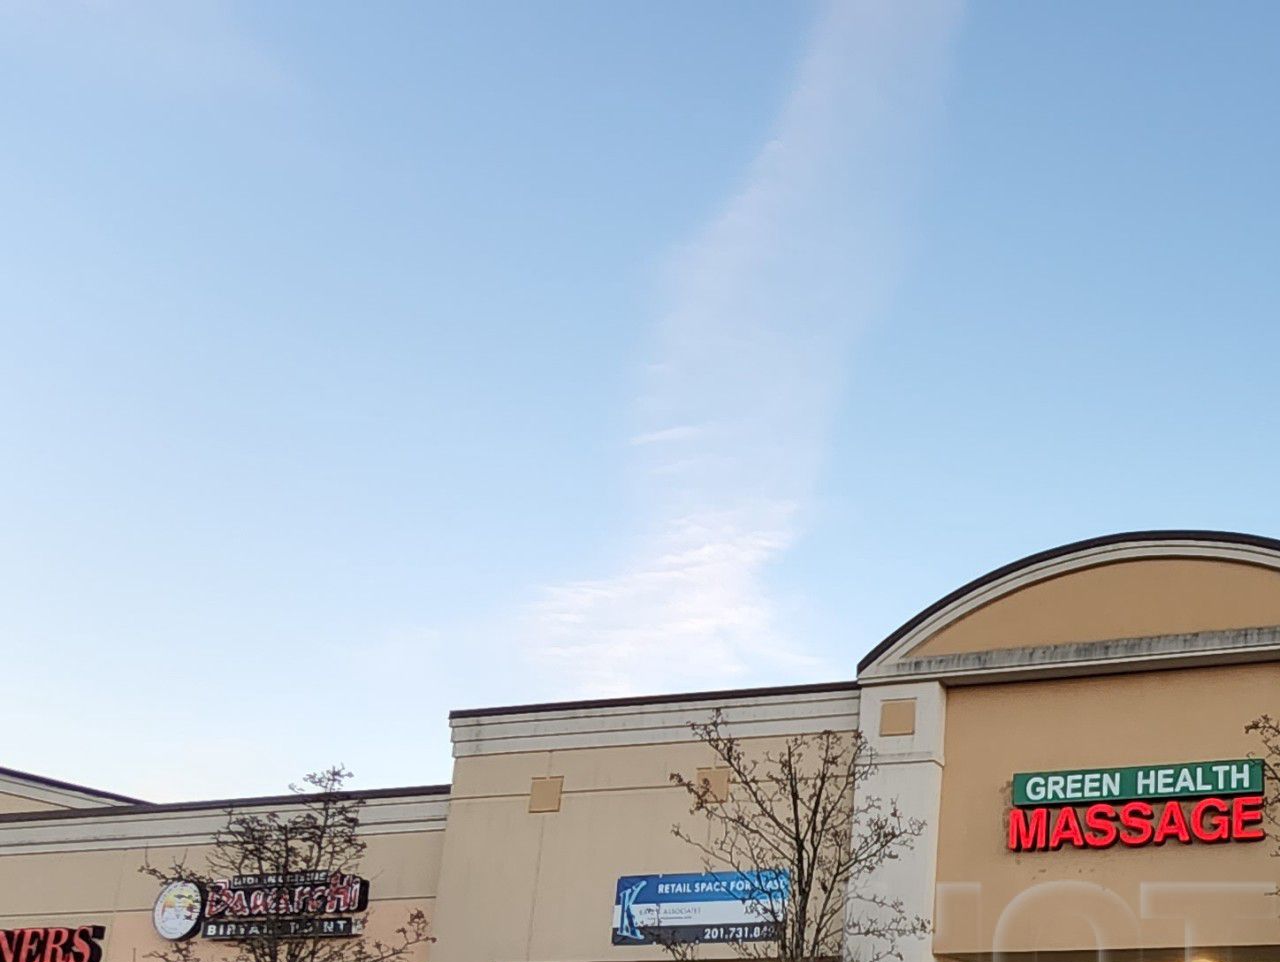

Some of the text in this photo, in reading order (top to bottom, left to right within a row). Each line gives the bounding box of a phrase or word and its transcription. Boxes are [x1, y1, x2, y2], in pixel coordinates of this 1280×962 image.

[1026, 764, 1250, 801] GREEN HEALTH
[1007, 796, 1266, 851] MASSAGE
[657, 883, 692, 895] RETAIL
[694, 882, 727, 894] SPACE
[729, 880, 751, 892] FOR
